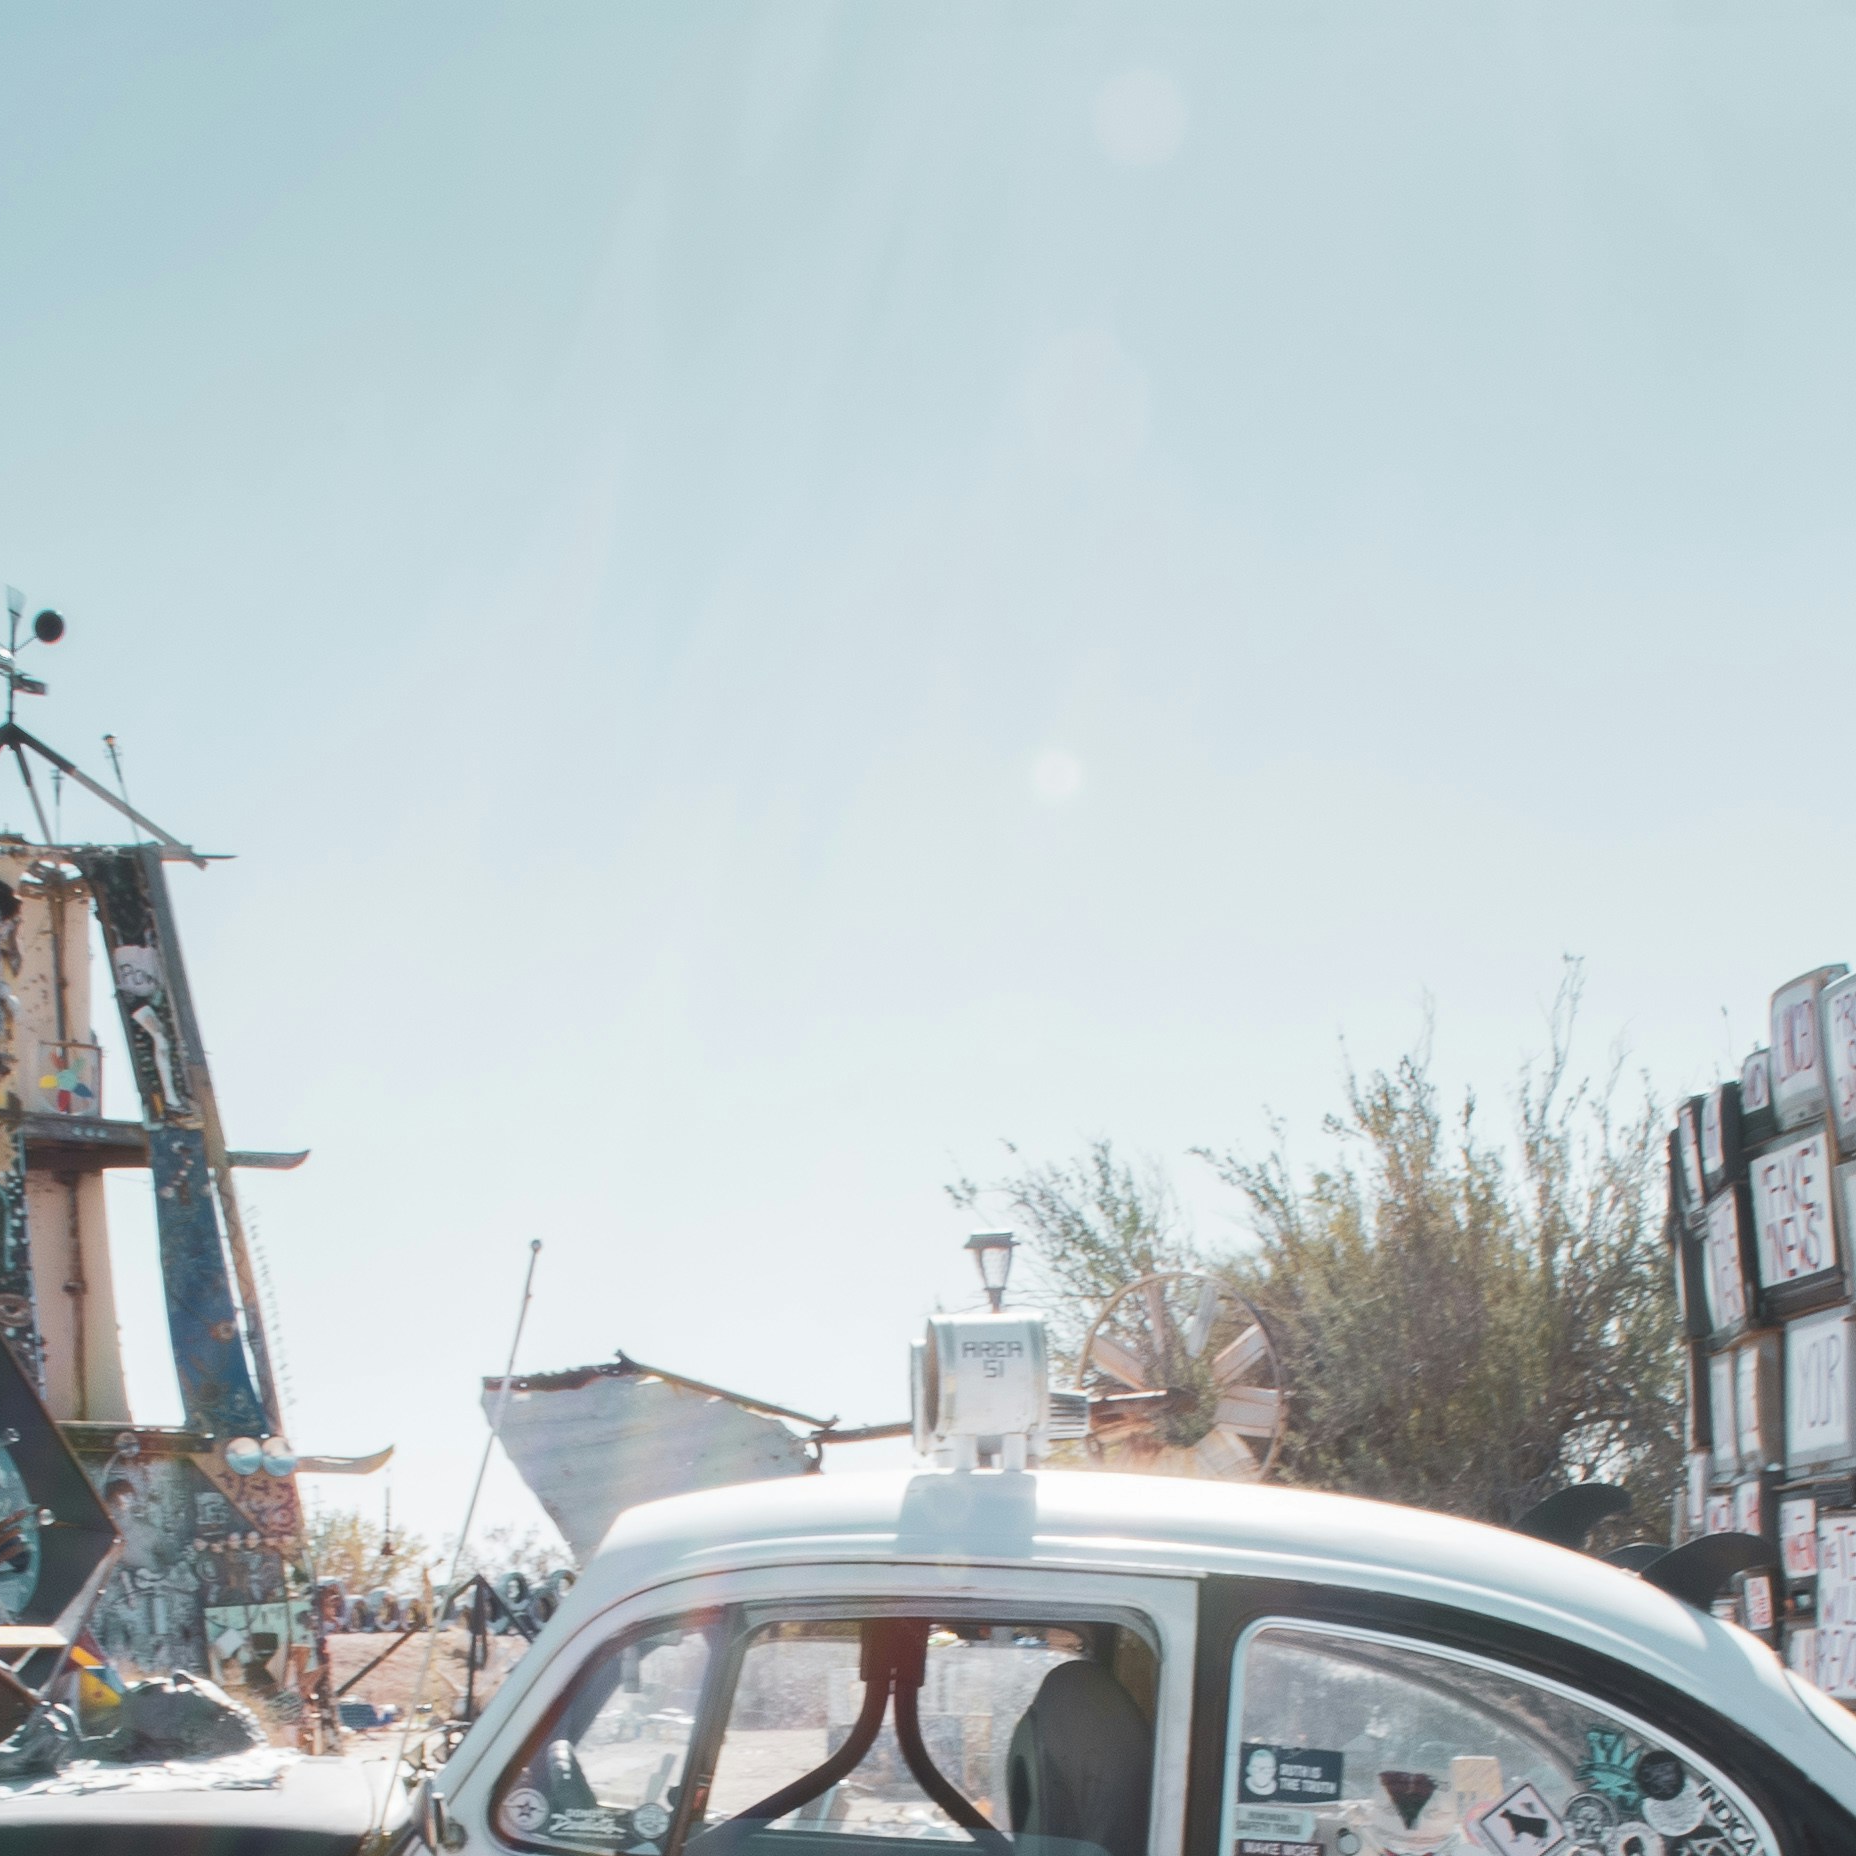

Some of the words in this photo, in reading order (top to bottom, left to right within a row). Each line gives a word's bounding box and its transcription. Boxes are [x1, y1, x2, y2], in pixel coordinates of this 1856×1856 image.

[963, 1341, 1023, 1358] AREA
[1698, 1784, 1757, 1856] INDICA
[1244, 1841, 1280, 1856] MAKE
